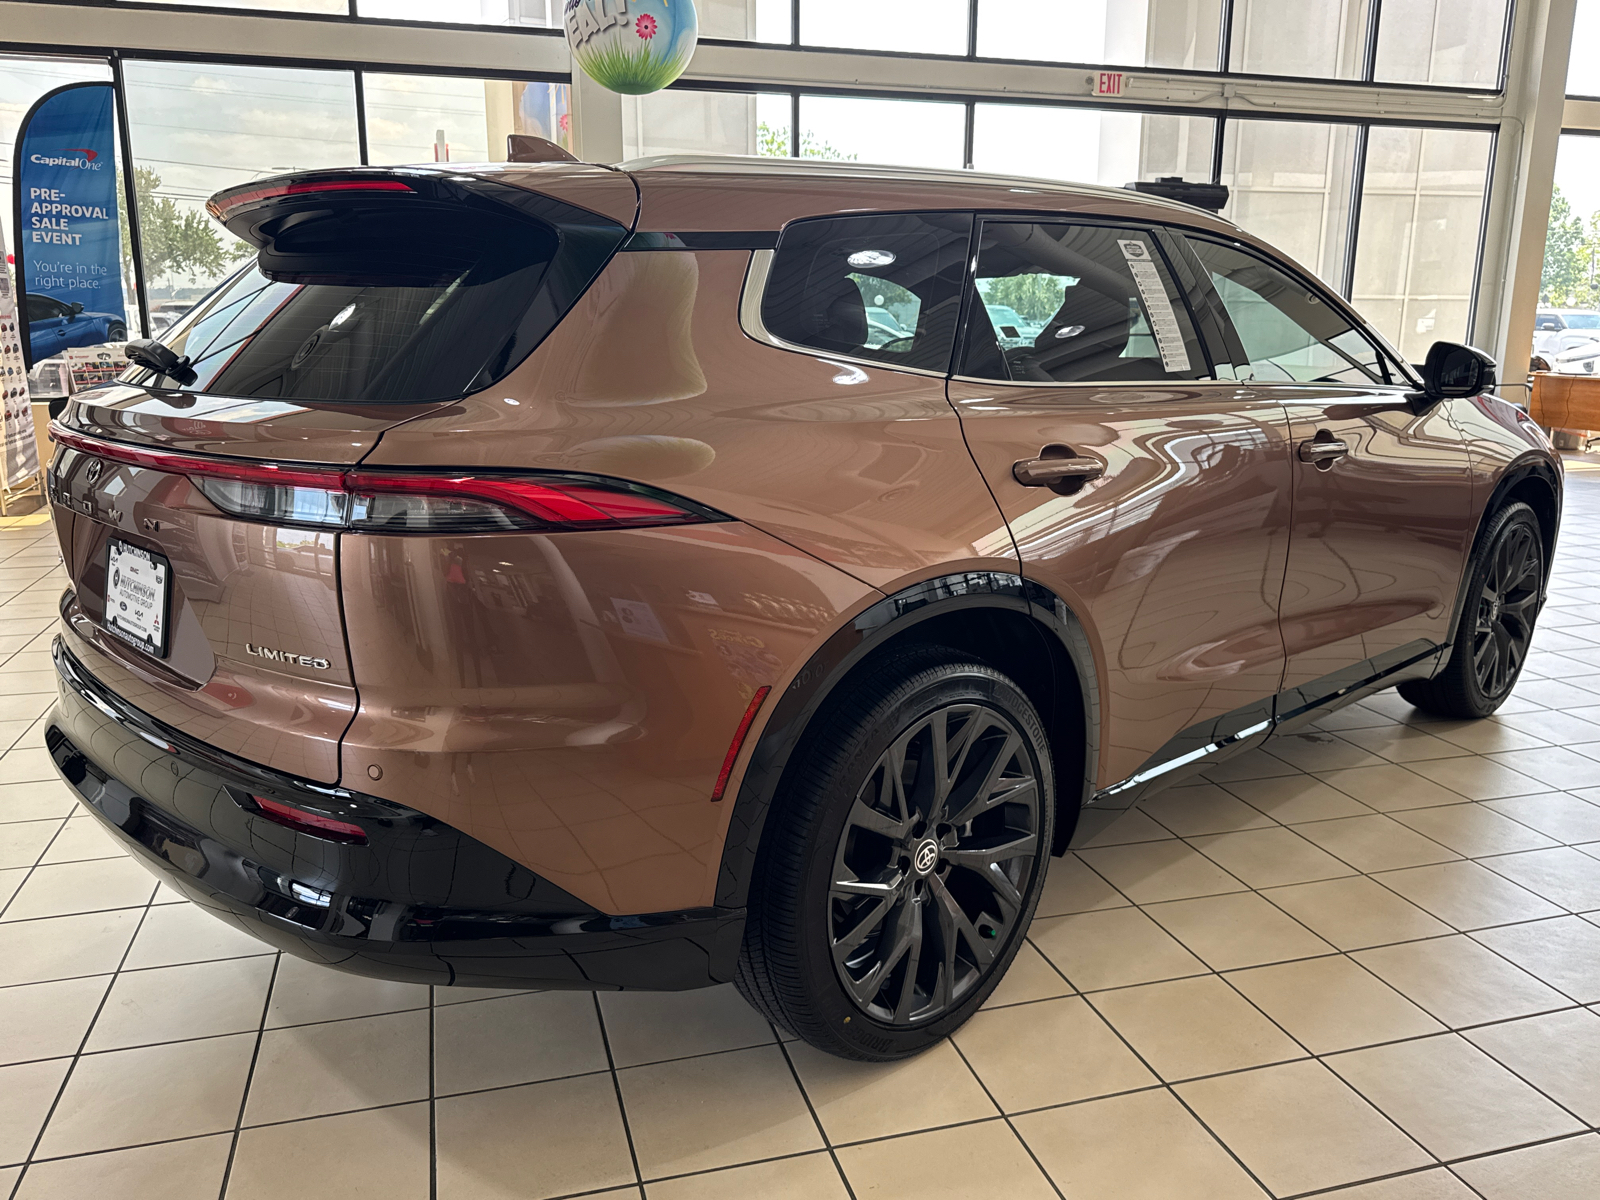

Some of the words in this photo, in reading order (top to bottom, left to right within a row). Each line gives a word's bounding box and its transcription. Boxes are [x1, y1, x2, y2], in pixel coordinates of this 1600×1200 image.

[565, 0, 628, 47] EAL!
[1099, 73, 1123, 95] EXIT
[30, 187, 66, 201] PRE-
[31, 202, 109, 220] APPROVAL
[31, 216, 69, 231] SALE
[32, 231, 82, 246] EVENT
[33, 259, 73, 273] You're
[76, 261, 87, 274] in
[91, 263, 107, 276] the
[35, 274, 65, 291] right
[68, 275, 101, 291] place.
[119, 574, 156, 601] HUTCHINSON
[140, 597, 153, 609] GROUP
[245, 643, 331, 670] LIMITED
[992, 682, 1047, 755] BRIDGESTONE
